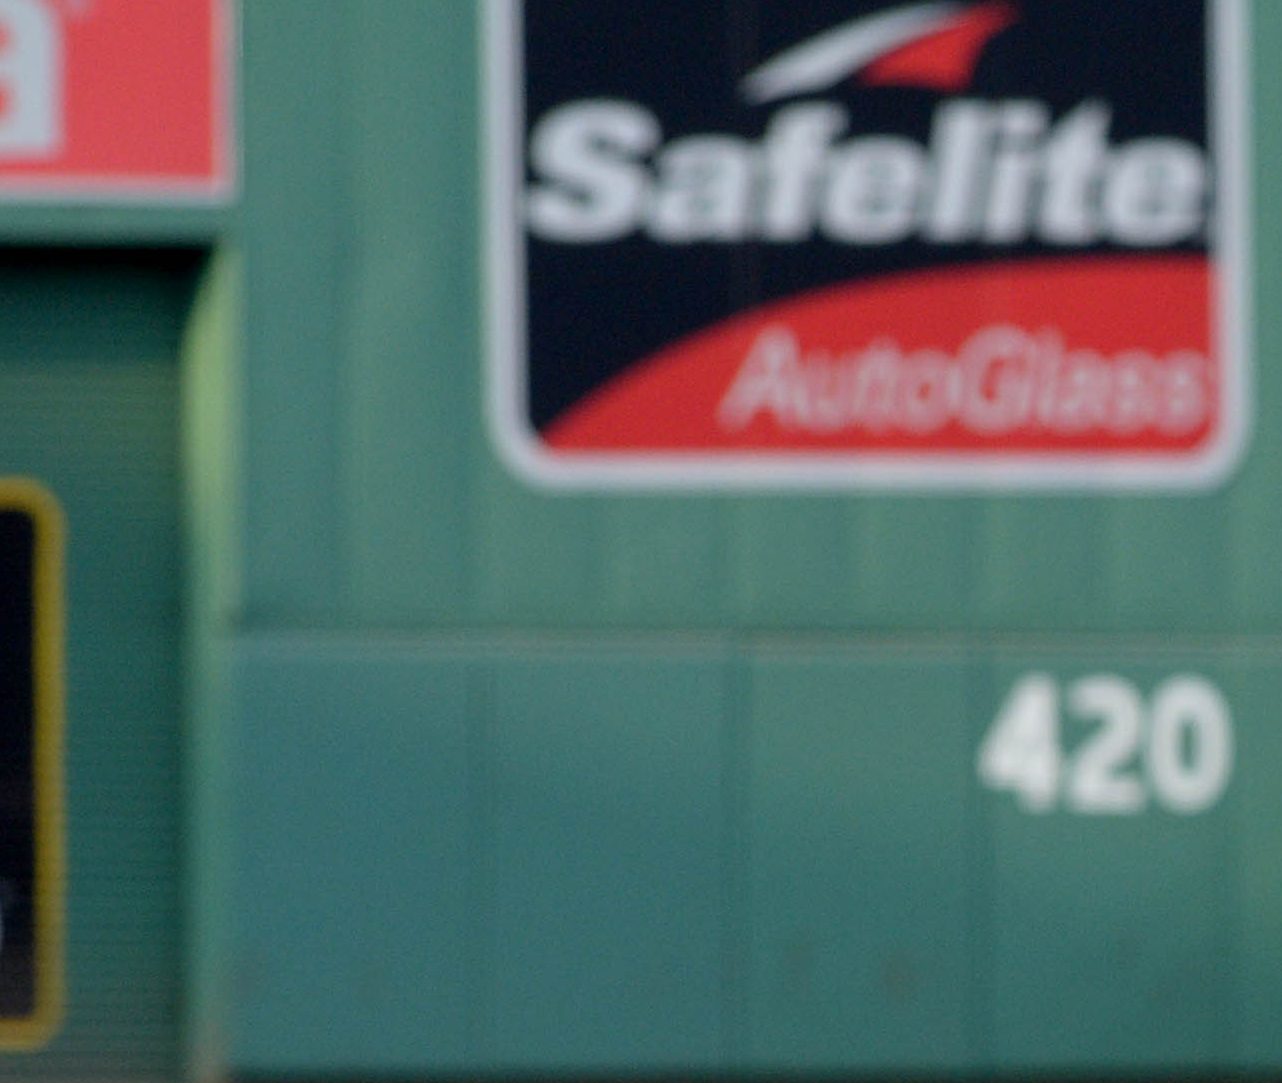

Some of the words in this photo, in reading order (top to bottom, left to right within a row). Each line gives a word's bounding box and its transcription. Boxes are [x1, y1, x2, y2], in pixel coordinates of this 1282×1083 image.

[528, 100, 1203, 241] Safelite
[718, 325, 1210, 432] AutoGlass
[978, 672, 1232, 813] 420
